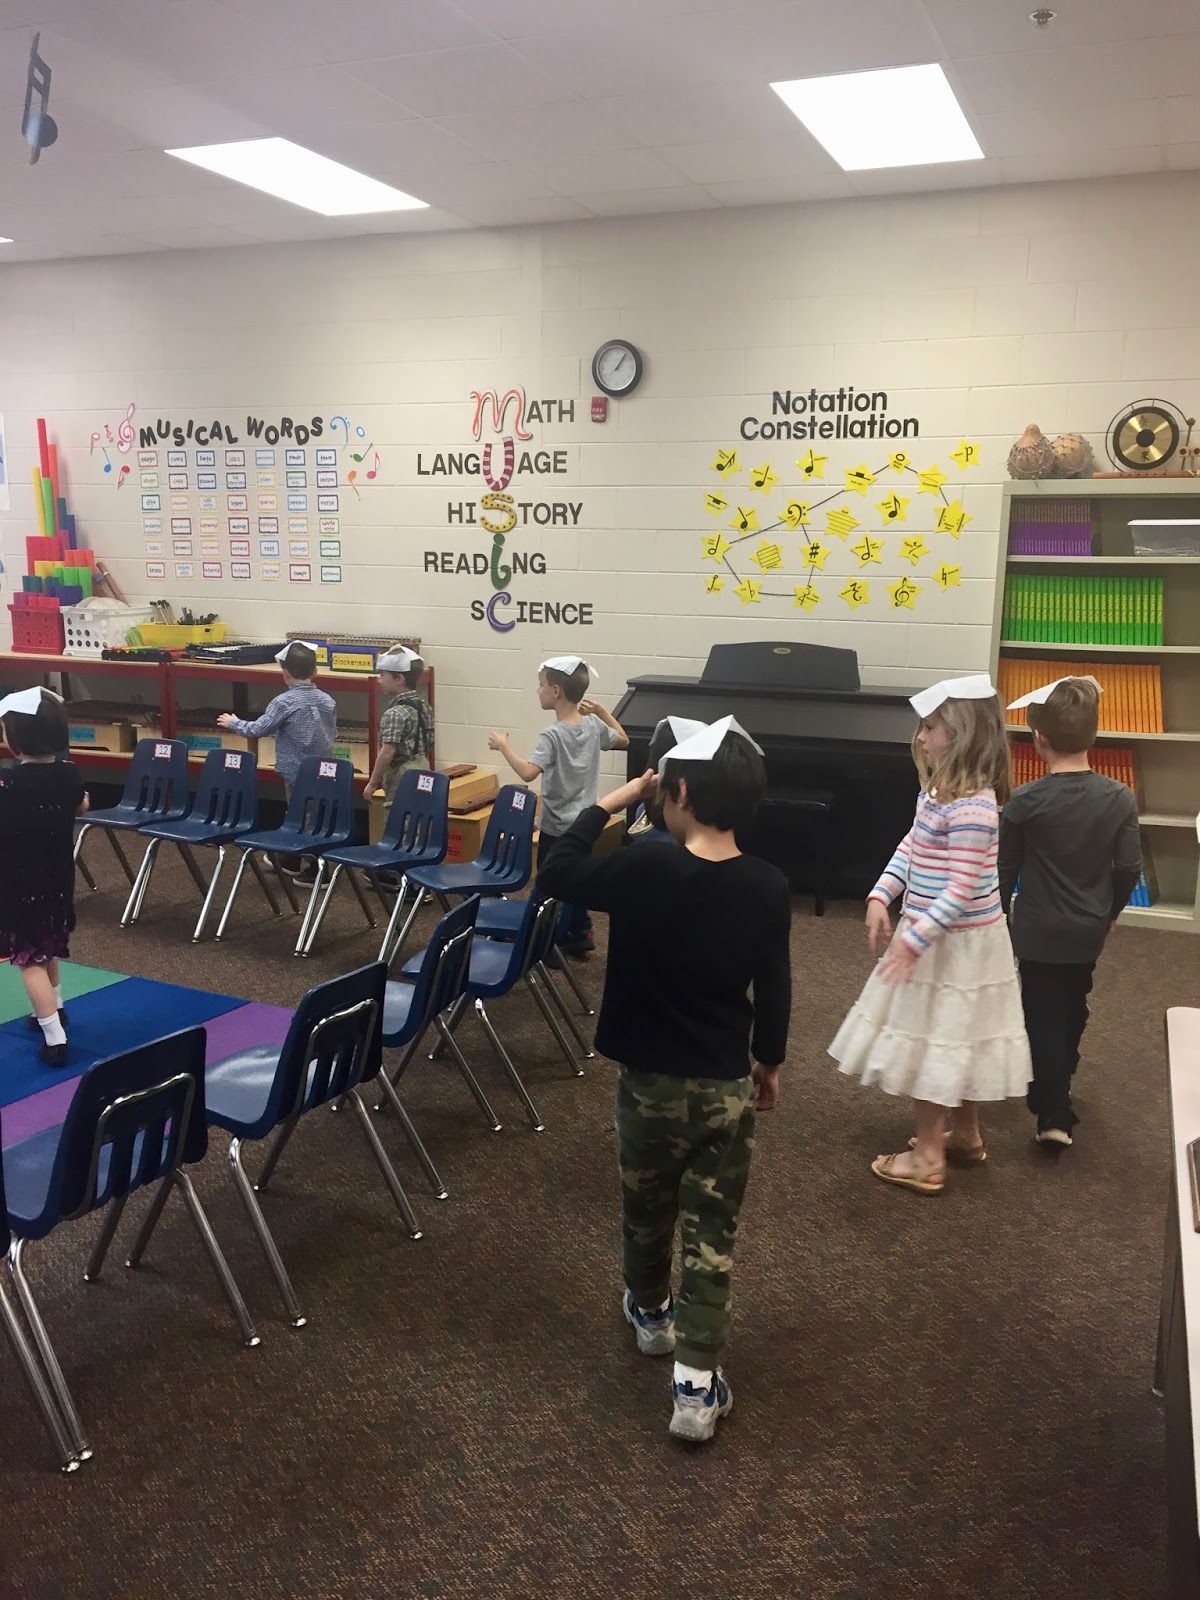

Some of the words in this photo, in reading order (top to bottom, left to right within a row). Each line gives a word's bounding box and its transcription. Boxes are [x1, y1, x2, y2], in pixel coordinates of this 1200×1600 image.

[470, 384, 575, 441] MATH
[772, 387, 888, 415] Notation
[139, 419, 239, 448] MUSICAL
[246, 416, 323, 445] WORDS
[740, 413, 919, 441] Constellation
[417, 436, 568, 491] LANGUAGE
[448, 493, 583, 533] HISTORY
[471, 591, 594, 633] SCIENCE
[158, 744, 169, 754] 12
[229, 755, 239, 766] 13
[323, 764, 334, 774] 14
[421, 777, 431, 788] 15
[516, 794, 523, 806] 16
